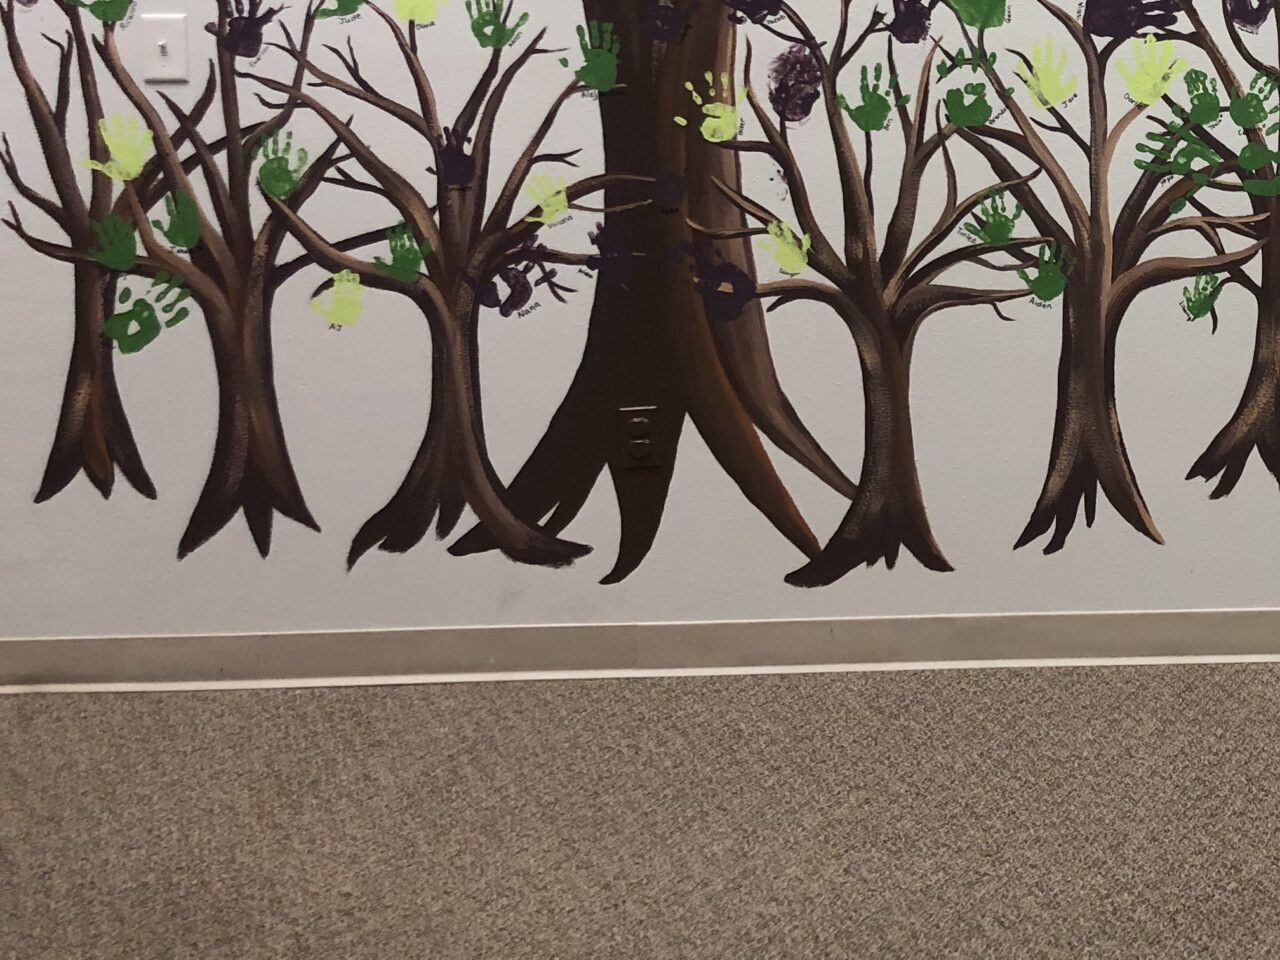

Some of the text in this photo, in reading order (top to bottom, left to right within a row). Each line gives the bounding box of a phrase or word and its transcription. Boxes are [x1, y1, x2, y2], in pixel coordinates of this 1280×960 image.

[1029, 299, 1052, 309] Aiden
[517, 302, 541, 318] Nana
[329, 323, 342, 332] AJ
